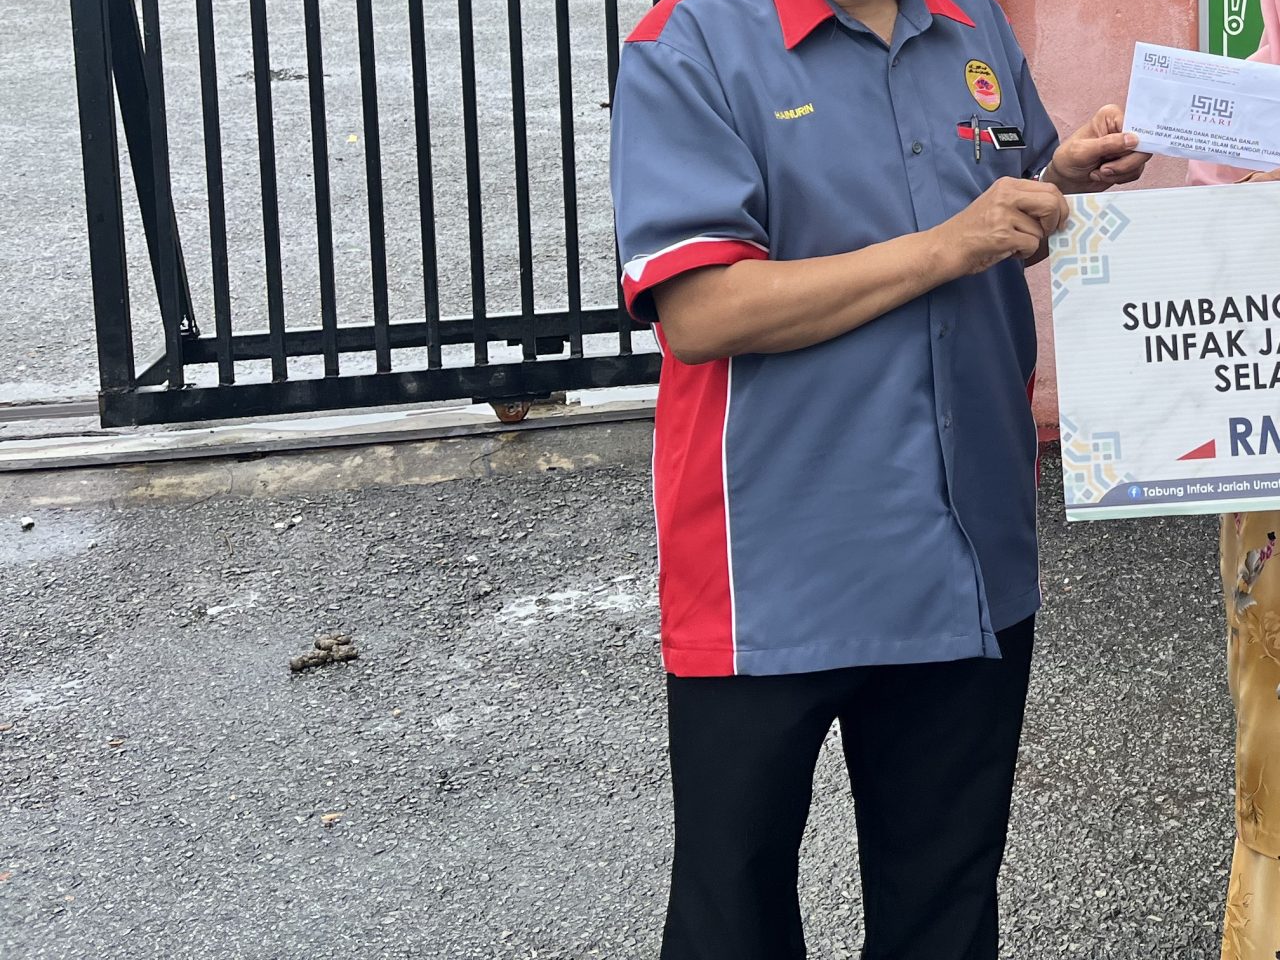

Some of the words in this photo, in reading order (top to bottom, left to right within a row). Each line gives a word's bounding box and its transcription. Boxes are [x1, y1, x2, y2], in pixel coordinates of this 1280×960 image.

[1190, 114, 1232, 126] TIJARI
[1131, 126, 1154, 136] TABUNG
[1154, 131, 1172, 140] INFAK
[1172, 134, 1194, 143] JARIAH
[1194, 138, 1210, 146] UMAT
[1211, 140, 1229, 149] ISLAM
[1230, 143, 1262, 154] SELANGOR
[1156, 124, 1193, 136] SUMBANGAN
[1193, 130, 1210, 138] DANA
[1210, 133, 1238, 143] BENCANA
[1238, 138, 1260, 146] BANJIR
[1170, 142, 1194, 150] KEPADA
[1208, 147, 1227, 155] TAMAN
[1145, 329, 1247, 363] INFAK
[1143, 485, 1184, 498] Tabung
[1186, 483, 1214, 494] Infak
[1217, 481, 1251, 492] Jariah
